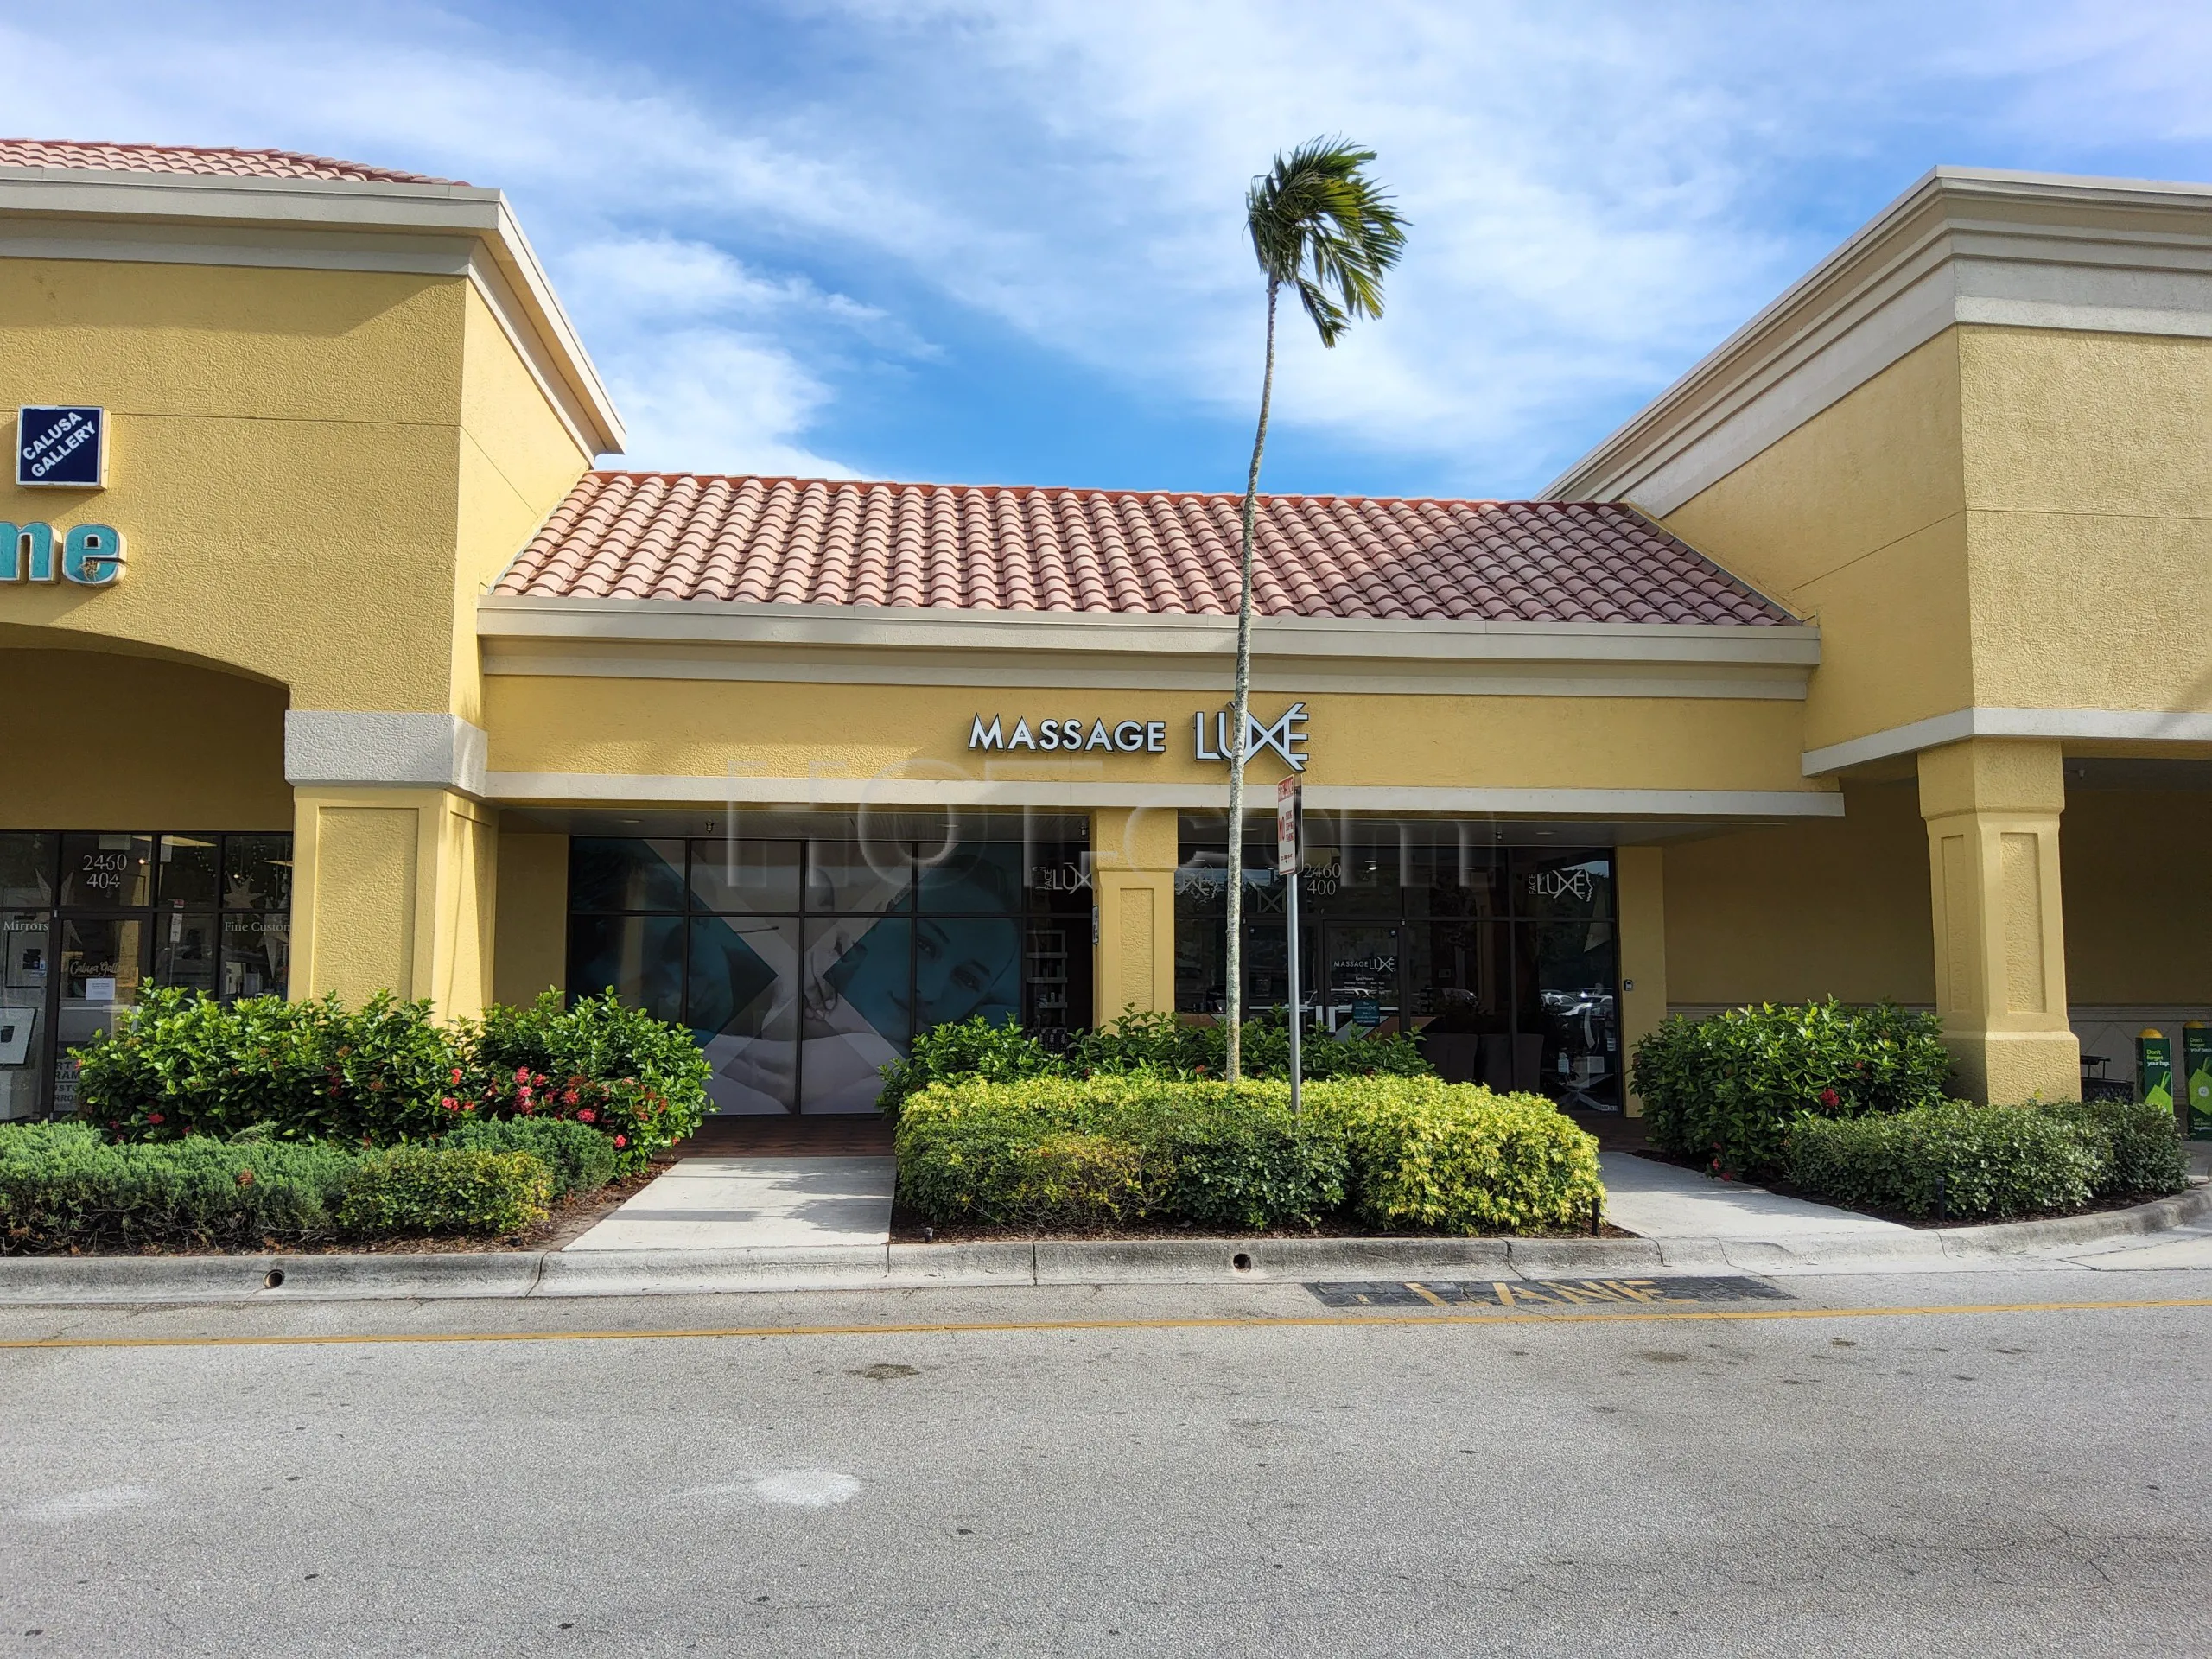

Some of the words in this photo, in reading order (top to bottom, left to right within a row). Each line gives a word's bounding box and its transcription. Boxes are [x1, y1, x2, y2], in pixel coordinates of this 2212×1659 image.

[22, 411, 83, 461] CALUSA
[31, 420, 96, 477] GALLERY
[968, 712, 1166, 753] MASSAGE
[82, 854, 128, 871] 2460
[1303, 863, 1342, 878] 2460
[86, 873, 121, 888] 404
[1307, 880, 1337, 895] 400
[1528, 874, 1536, 895] FACE
[3, 920, 49, 931] Mirrors
[224, 921, 249, 931] Fine
[70, 960, 99, 974] Calusa
